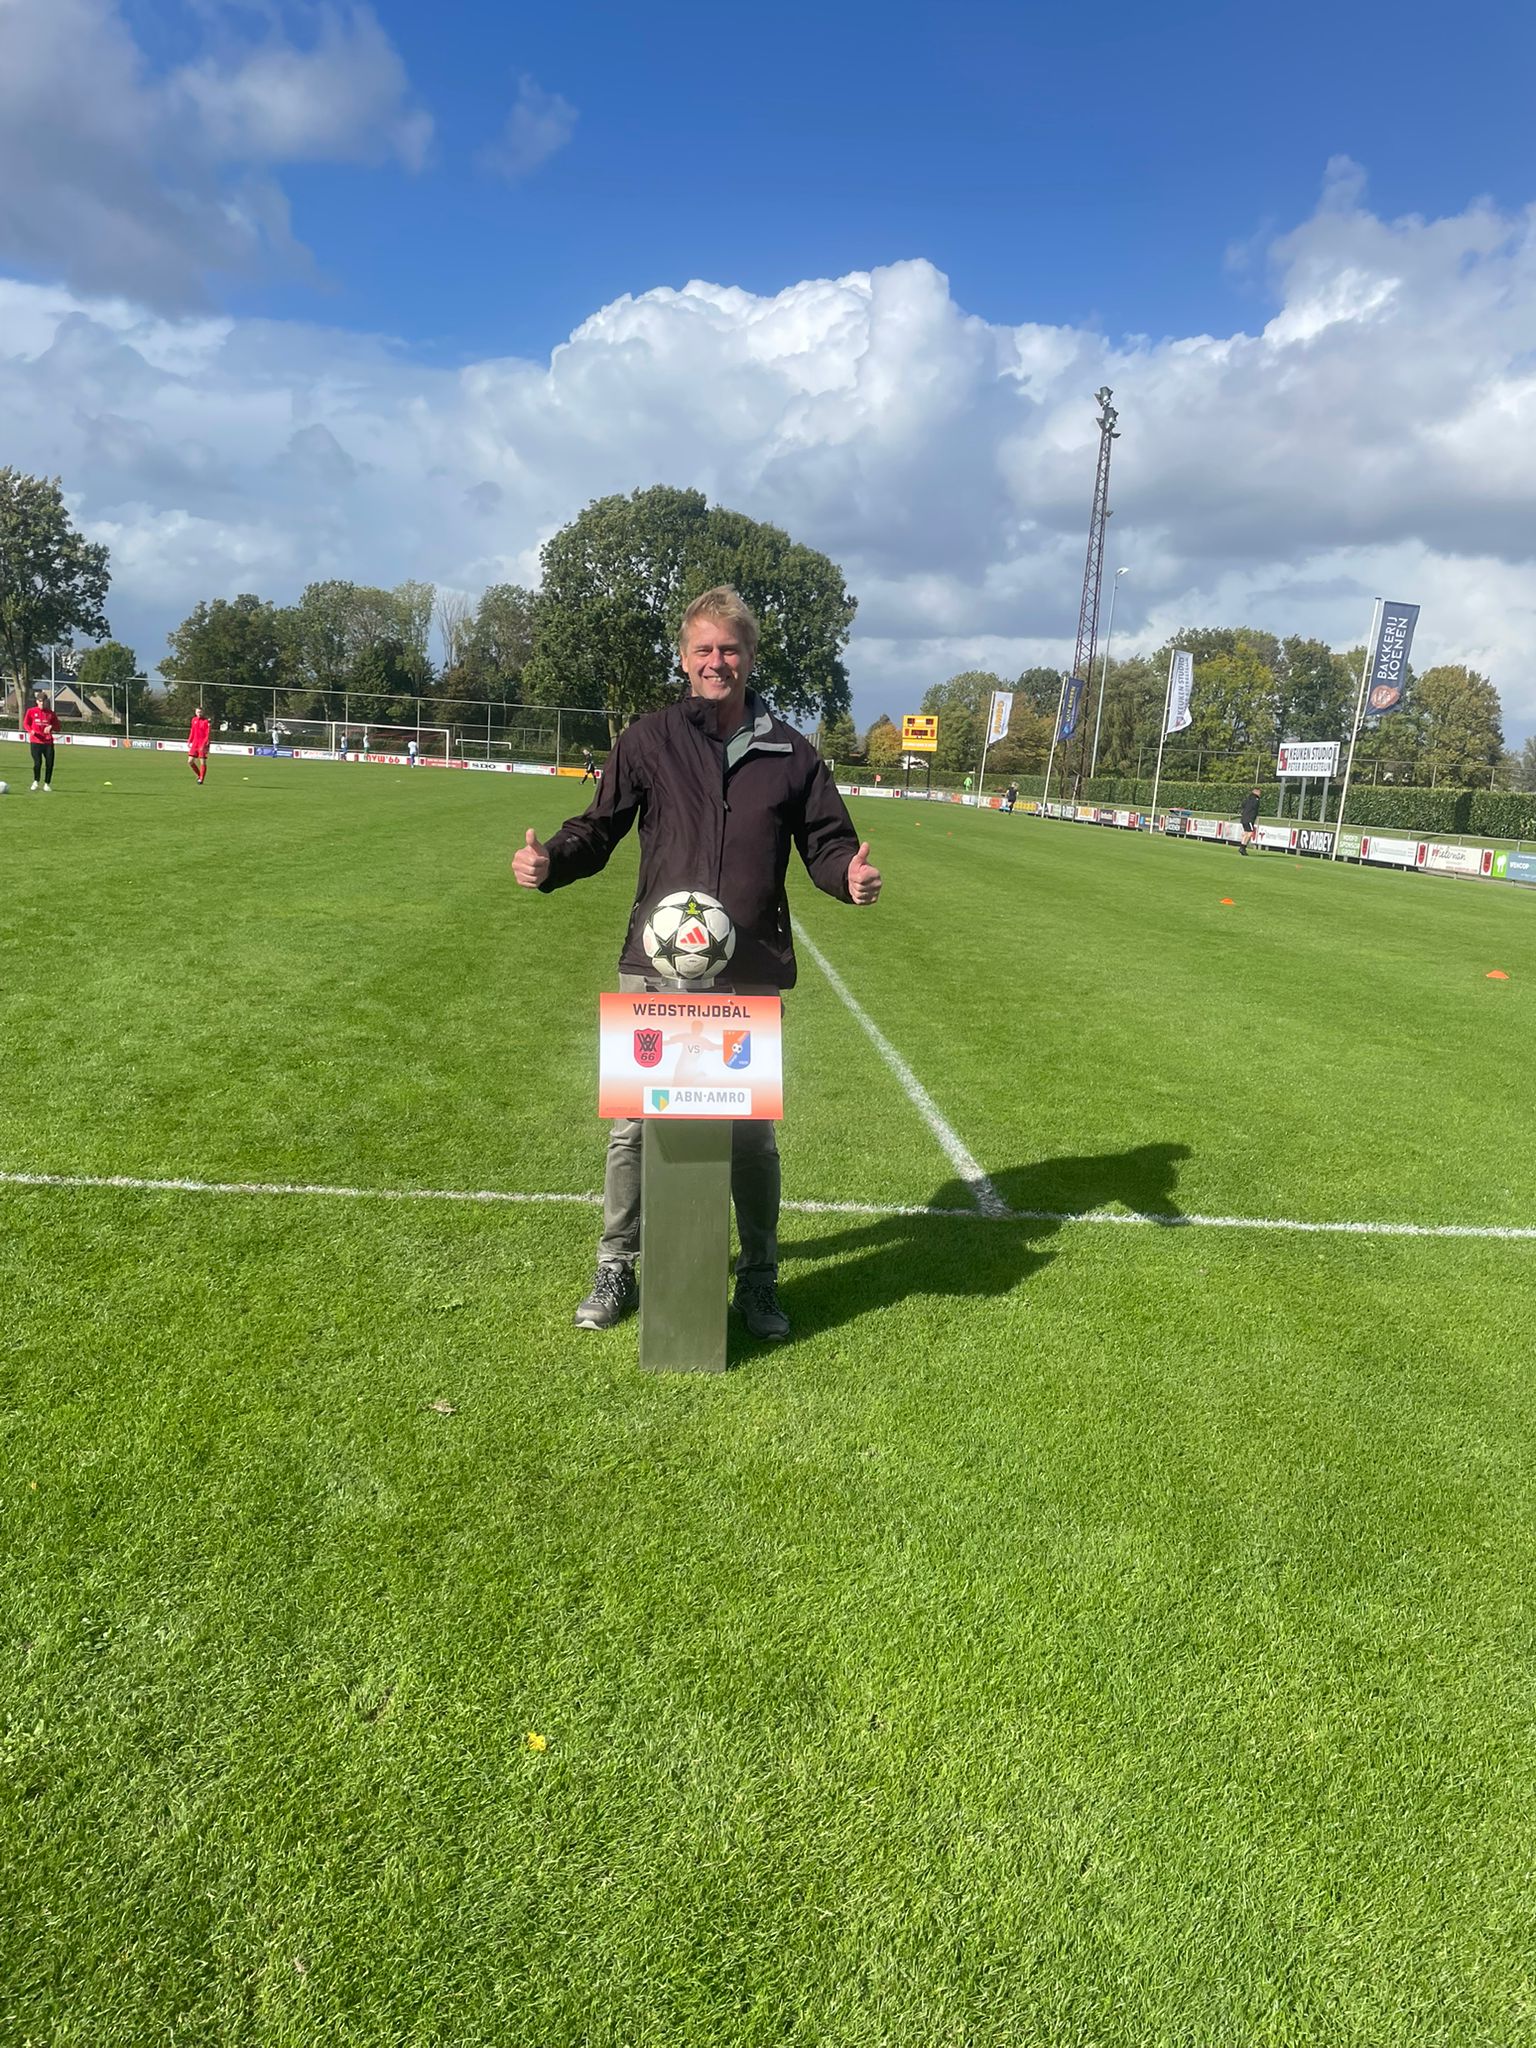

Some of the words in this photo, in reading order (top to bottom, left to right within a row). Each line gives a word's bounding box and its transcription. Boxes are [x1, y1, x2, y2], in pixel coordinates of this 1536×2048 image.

[1377, 617, 1398, 679] BAKKERIJ
[1387, 617, 1409, 680] KOENEN
[1290, 747, 1311, 760] KEUKEN
[1312, 746, 1333, 760] STUDIO
[1288, 762, 1300, 771] PETER
[1309, 831, 1333, 852] ROBEY
[633, 1003, 751, 1019] WEDSTRIJDBAL
[640, 1052, 656, 1061] 66
